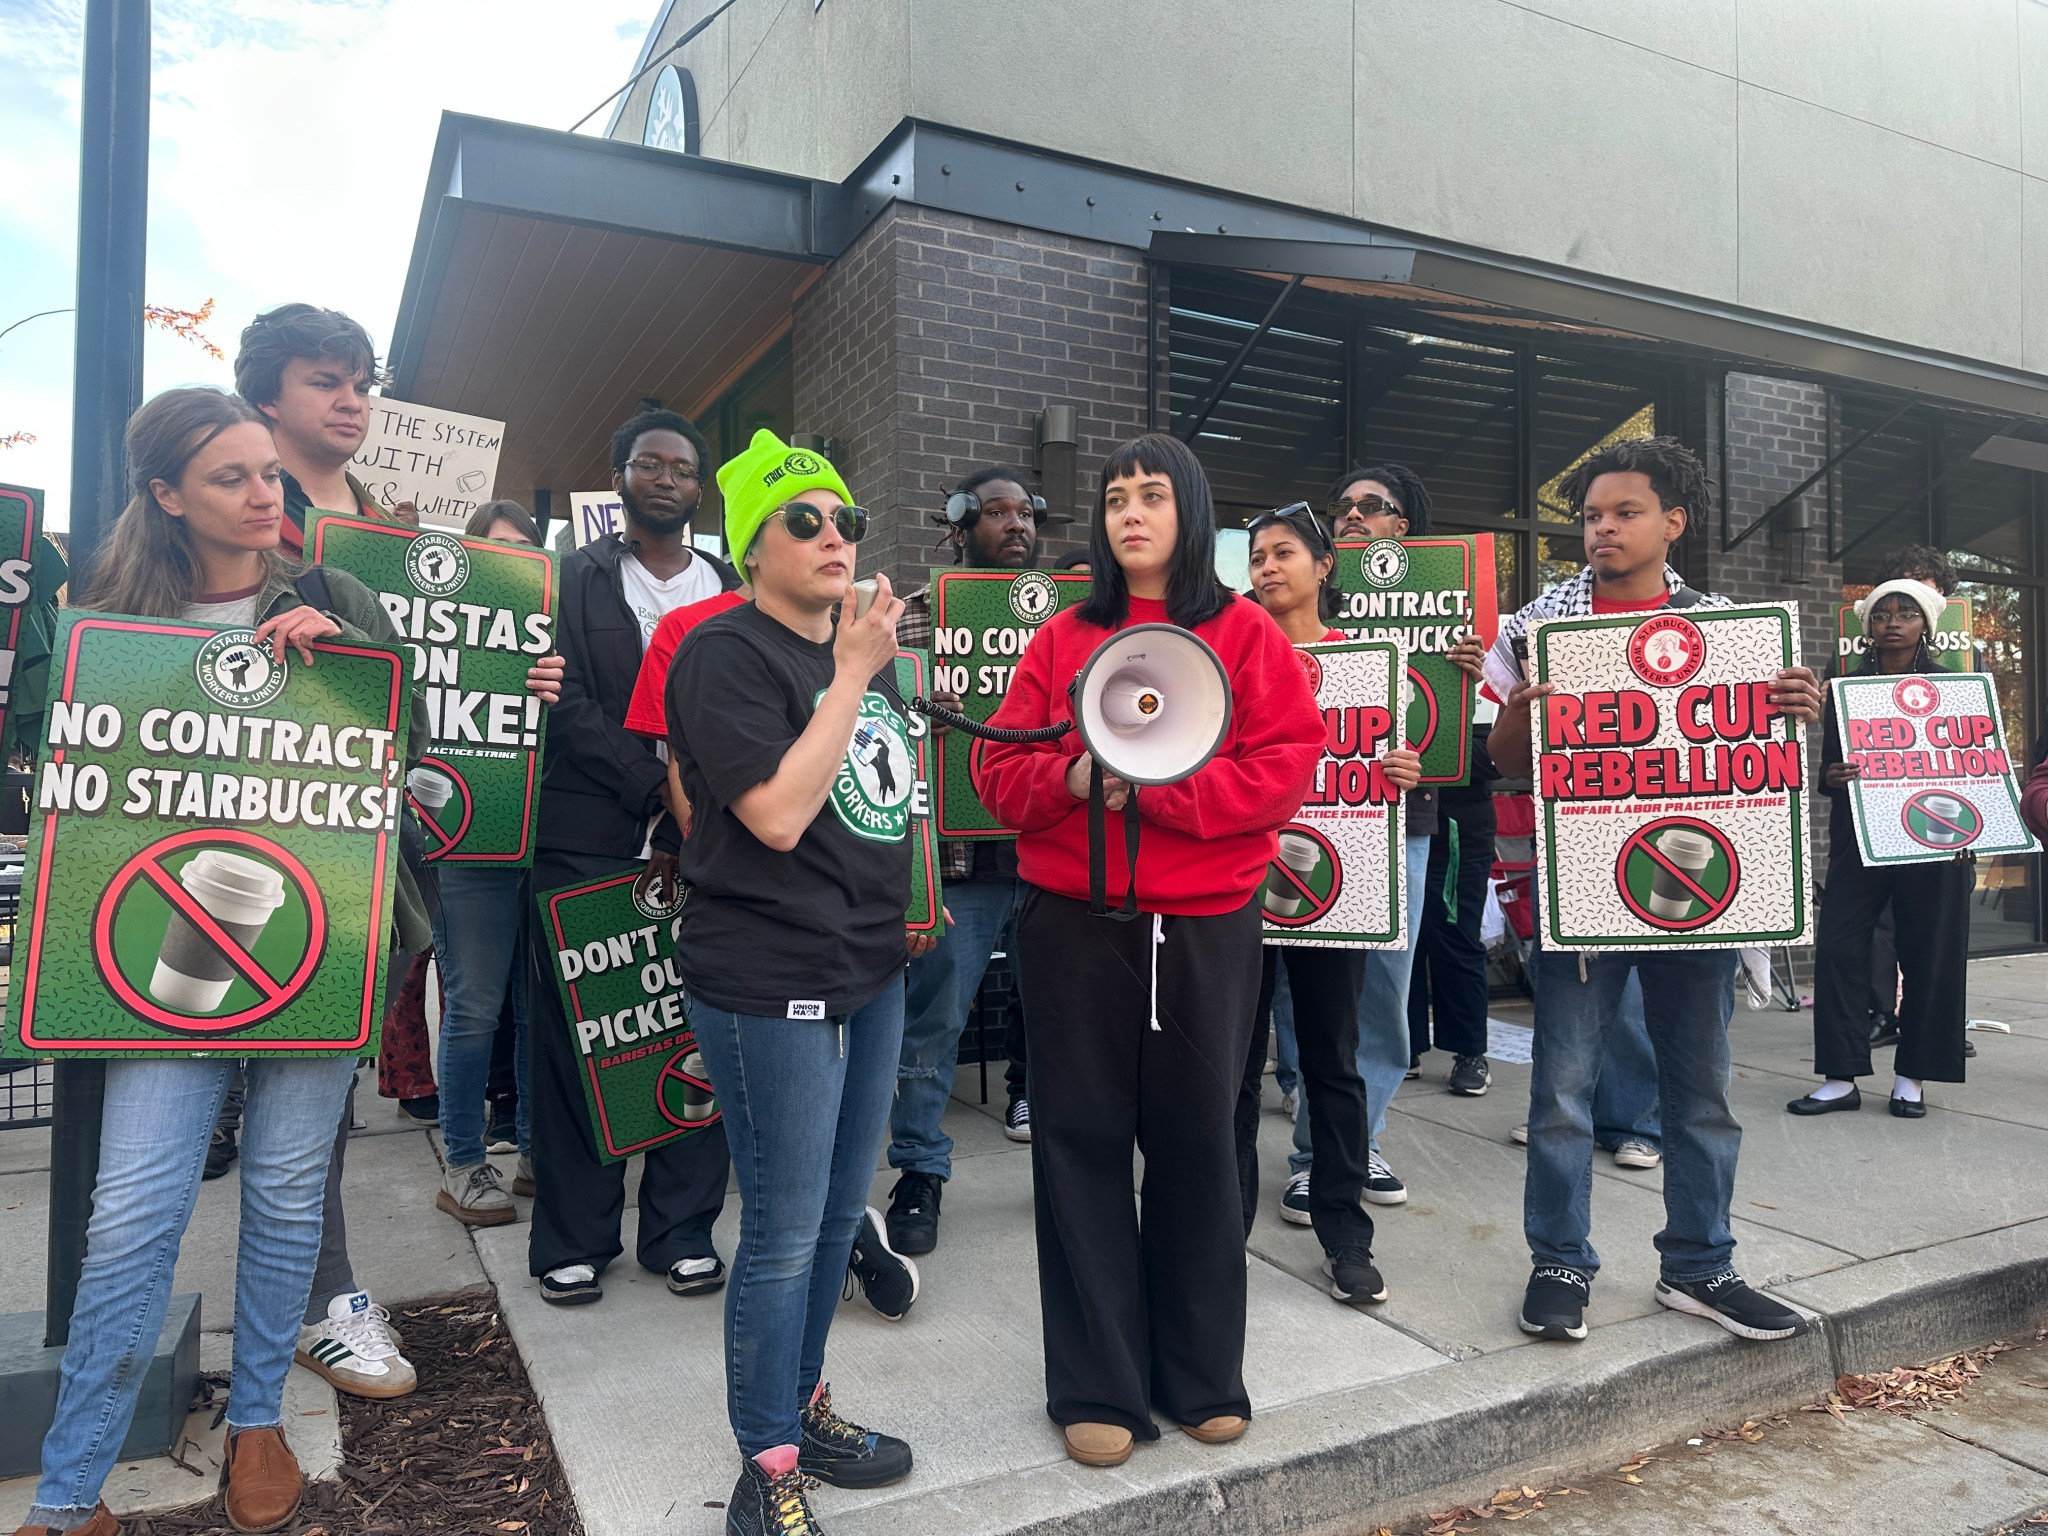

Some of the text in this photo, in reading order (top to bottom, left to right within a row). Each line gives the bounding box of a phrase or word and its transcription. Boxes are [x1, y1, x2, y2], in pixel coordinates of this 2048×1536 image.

[380, 410, 499, 450] THE SYSTEM
[352, 446, 443, 476] WITH
[763, 466, 786, 488] STRIKE
[410, 536, 465, 591] STARBUCKS WORKERS UNITED
[1364, 543, 1406, 585] STARBUCKS WORKERS UNITED
[1012, 575, 1055, 620] STARBUCKS WORKERS UNITED
[380, 592, 551, 654] RISTAS
[934, 627, 973, 655] NO
[1932, 631, 1971, 650] OSS
[1634, 619, 1700, 682] STARBUCKS WORKERS UNITED
[202, 664, 240, 703] WORKERS
[252, 671, 281, 702] UNITED
[934, 666, 970, 694] NO
[426, 687, 541, 746] IKE!
[1322, 706, 1391, 755] UP
[1547, 681, 1785, 746] RED CUP
[1848, 715, 1994, 749] RED CUP
[48, 701, 400, 780] NO CONTRACT,
[427, 747, 518, 759] ACTICE STRIKE
[1540, 741, 1800, 797] REBELLION
[1847, 749, 2010, 780] REBELLION
[40, 762, 400, 830] NO STARBUCKS!
[1294, 810, 1385, 819] ACTICE STRIKE
[1561, 797, 1786, 815] UNFAIR LABOR PRACTICE STRIKE
[672, 885, 684, 910] UNITED
[558, 924, 658, 982] DON'T
[640, 958, 683, 994] OU
[576, 991, 684, 1055] PICKE
[601, 1031, 695, 1068] BARISTAS ON
[1535, 1269, 1588, 1292] NAUTICA
